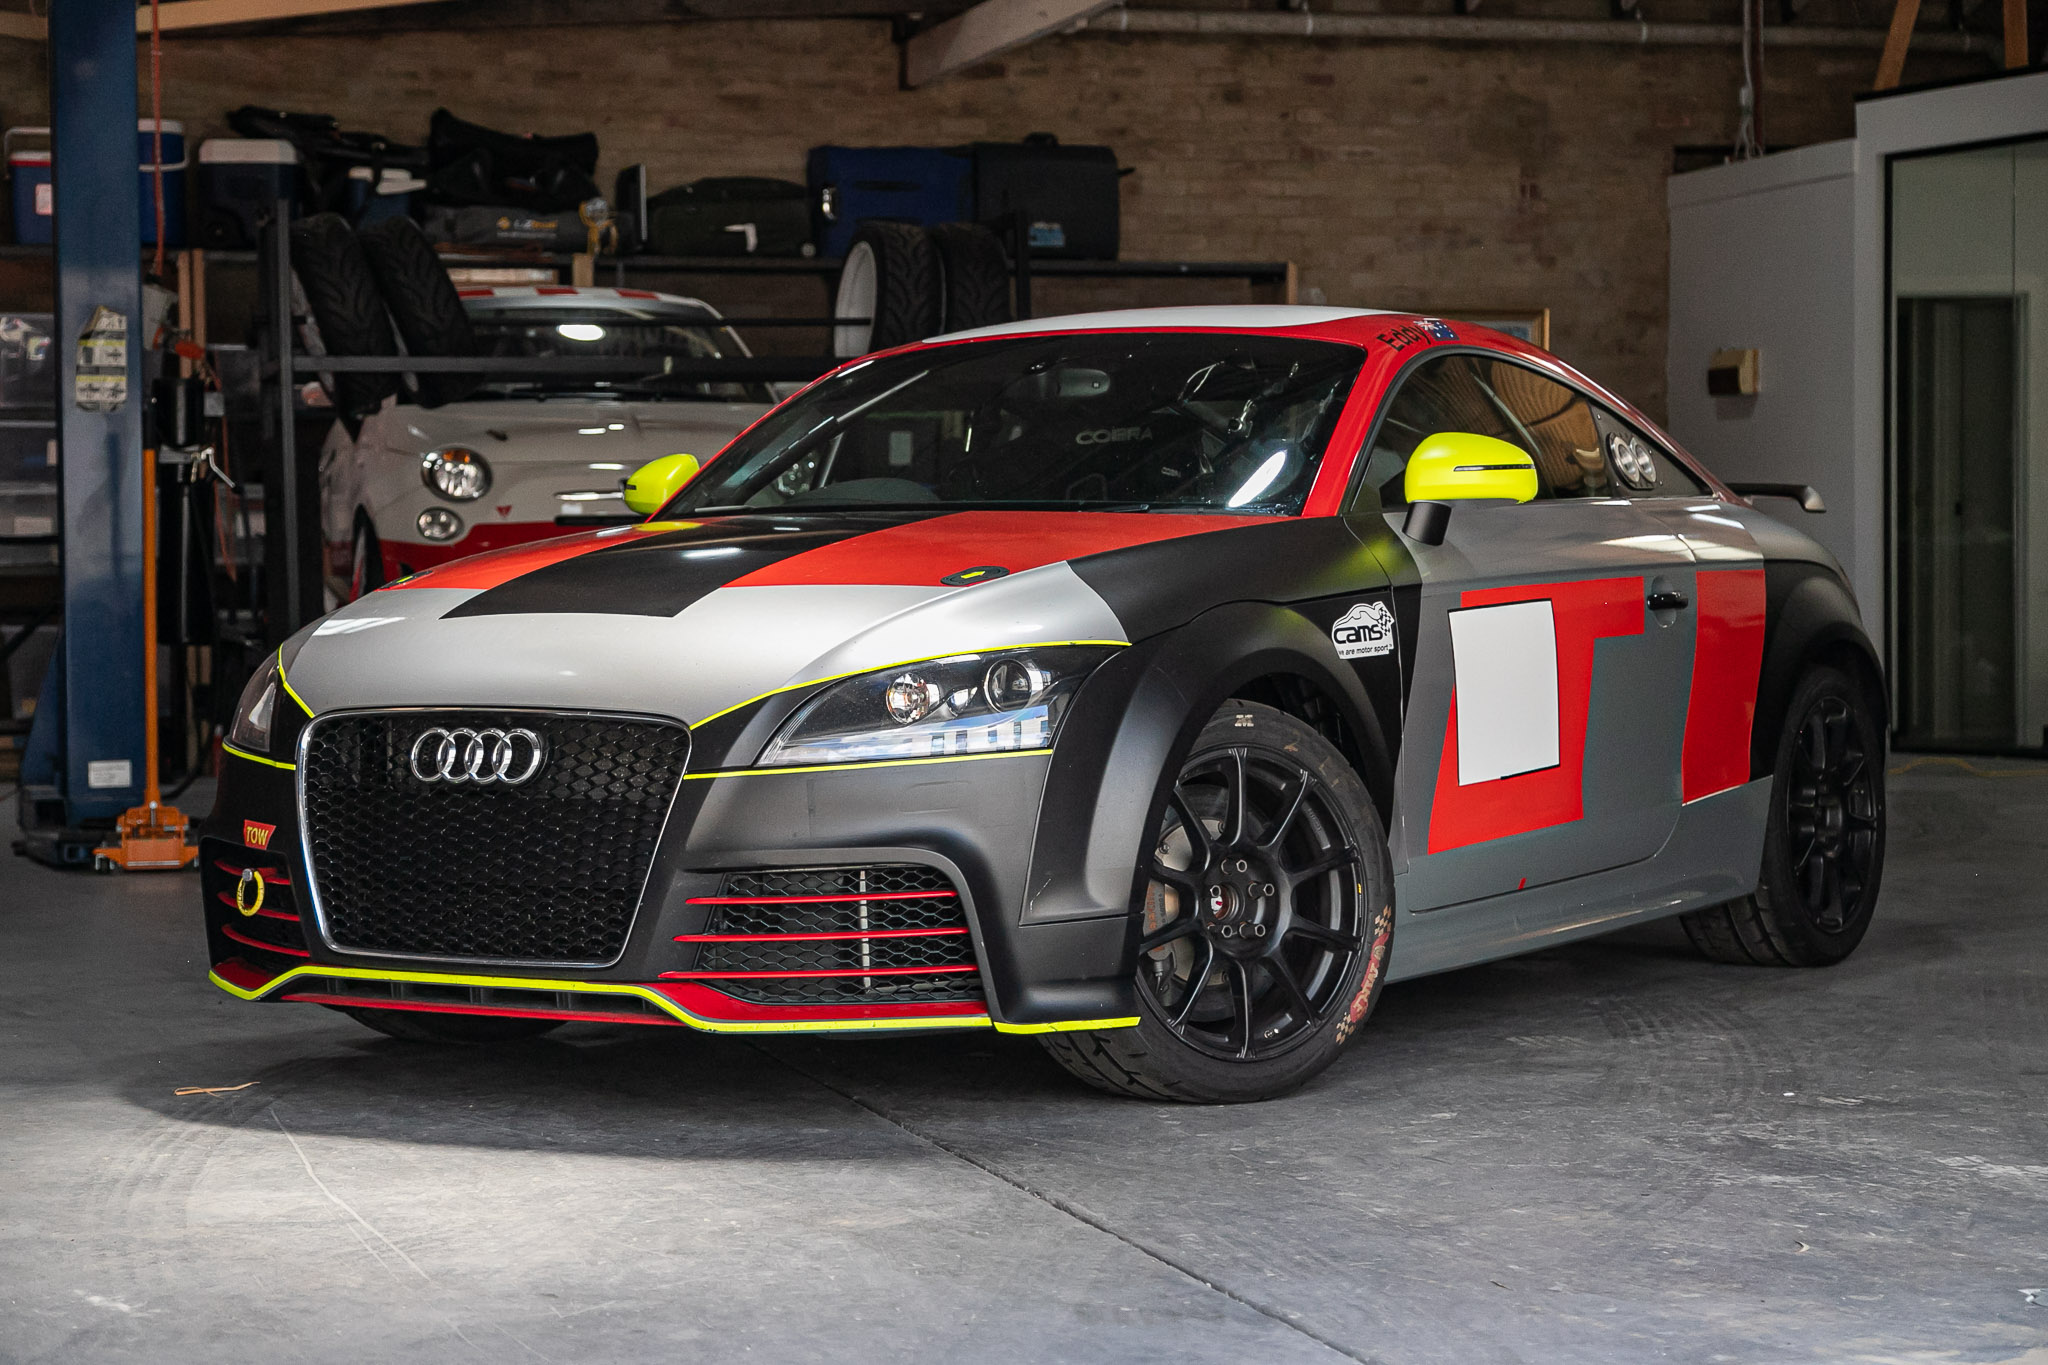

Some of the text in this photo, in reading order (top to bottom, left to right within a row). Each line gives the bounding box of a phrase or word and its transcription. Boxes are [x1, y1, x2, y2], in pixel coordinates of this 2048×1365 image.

[1376, 325, 1431, 352] Eddy
[1346, 648, 1356, 656] are
[1356, 646, 1373, 654] motor
[1374, 644, 1389, 653] sport
[246, 826, 269, 846] TOW
